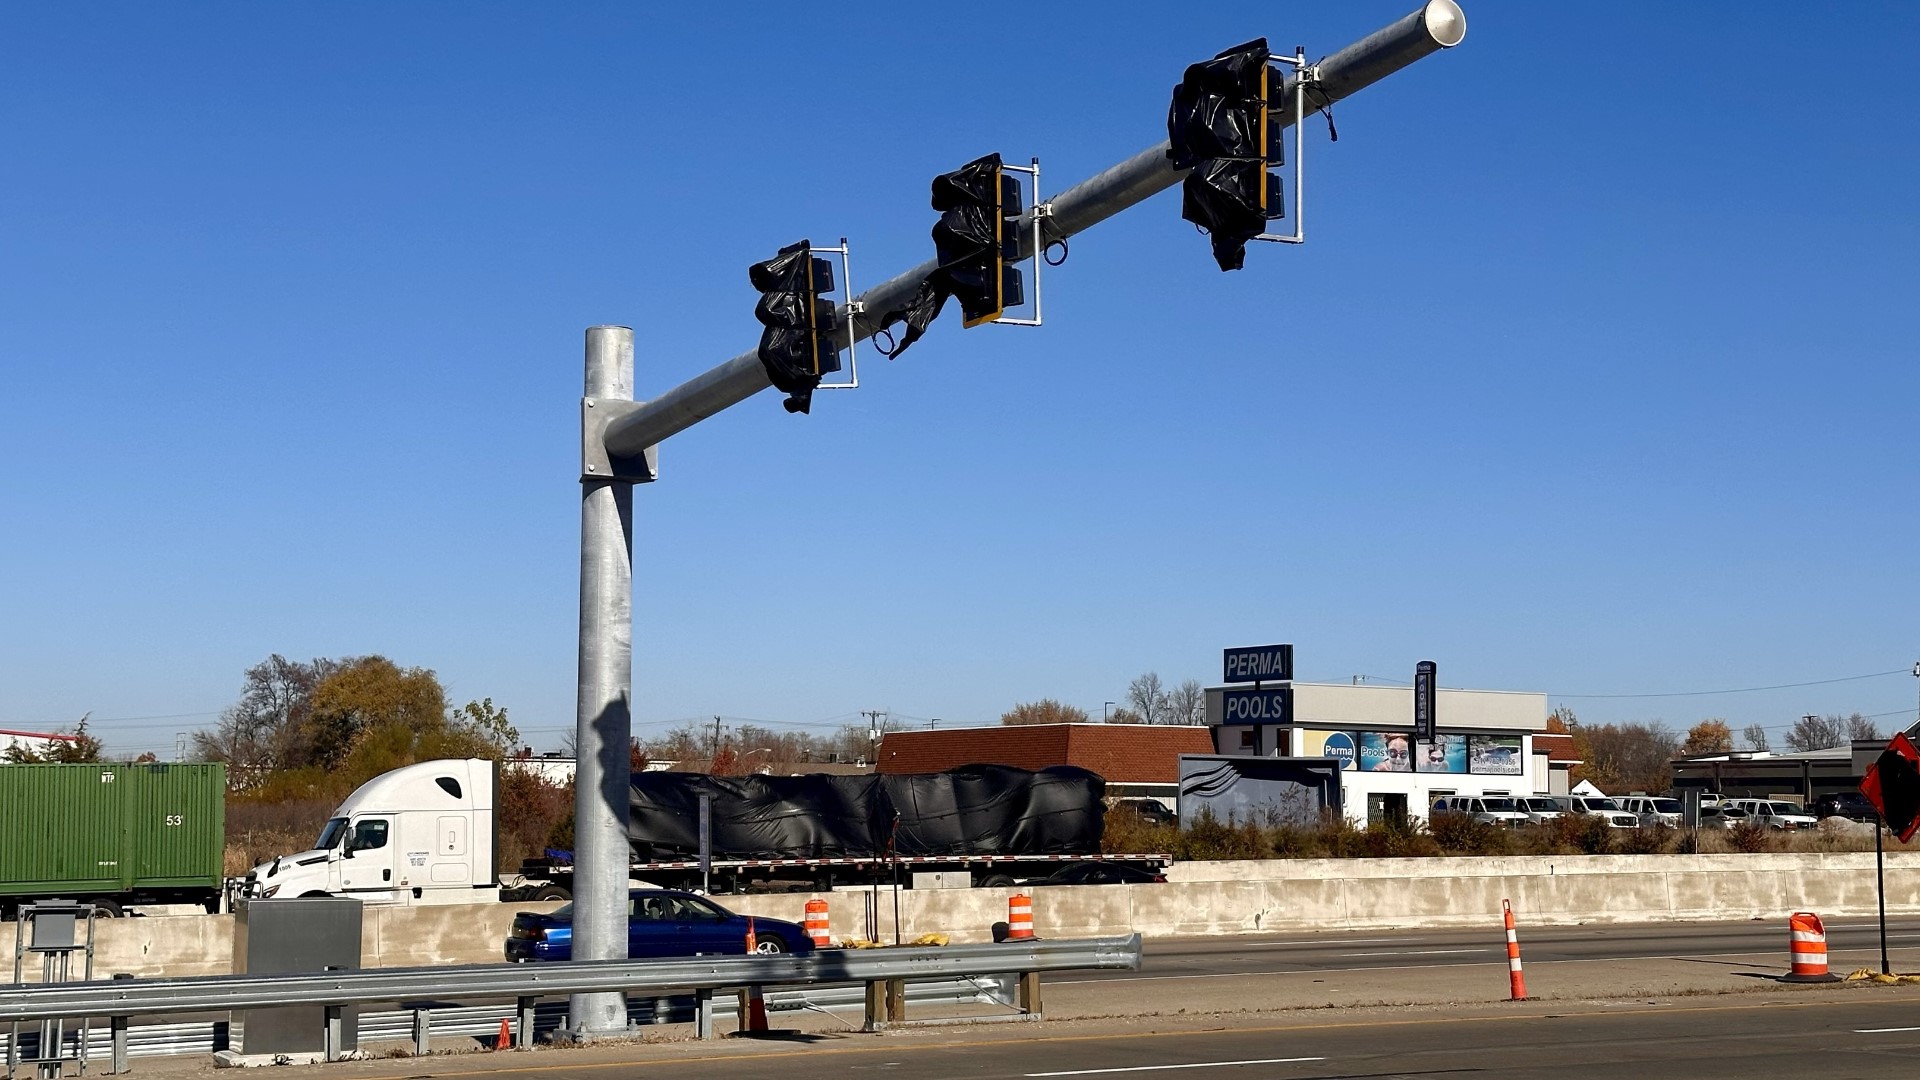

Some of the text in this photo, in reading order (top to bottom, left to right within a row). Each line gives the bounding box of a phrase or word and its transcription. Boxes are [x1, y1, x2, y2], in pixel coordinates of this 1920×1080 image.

[1226, 652, 1283, 677] PERMA
[1226, 696, 1283, 719] POOLS
[1325, 745, 1385, 757] Perma Pools
